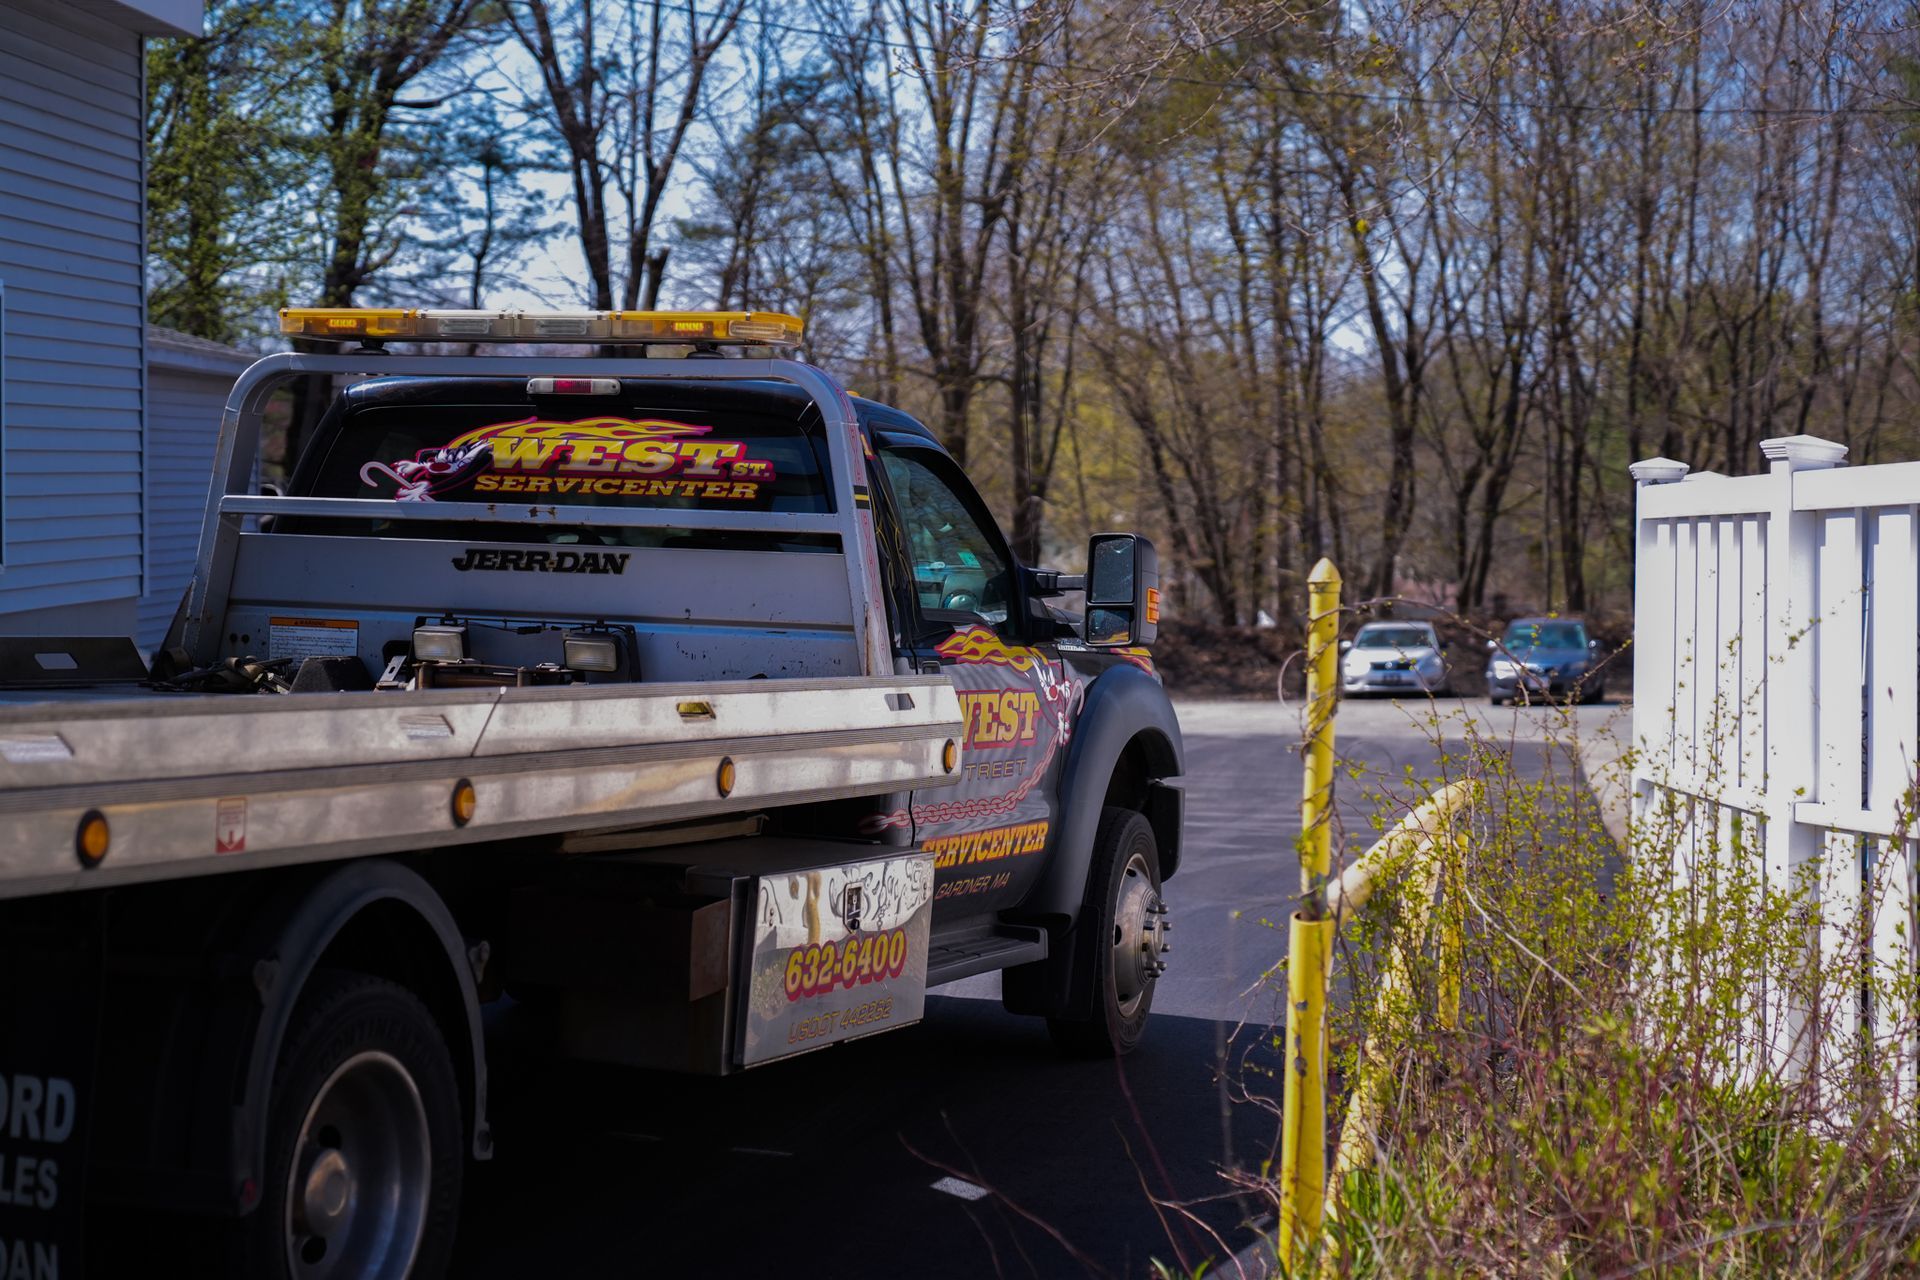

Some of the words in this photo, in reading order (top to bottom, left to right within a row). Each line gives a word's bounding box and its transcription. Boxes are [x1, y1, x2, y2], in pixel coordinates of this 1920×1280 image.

[486, 435, 741, 475] WEST
[731, 462, 771, 477] ST.
[473, 475, 759, 499] SERVICENTER
[991, 872, 1011, 890] MA
[786, 929, 907, 999] 632-6400
[0, 1072, 76, 1143] RD
